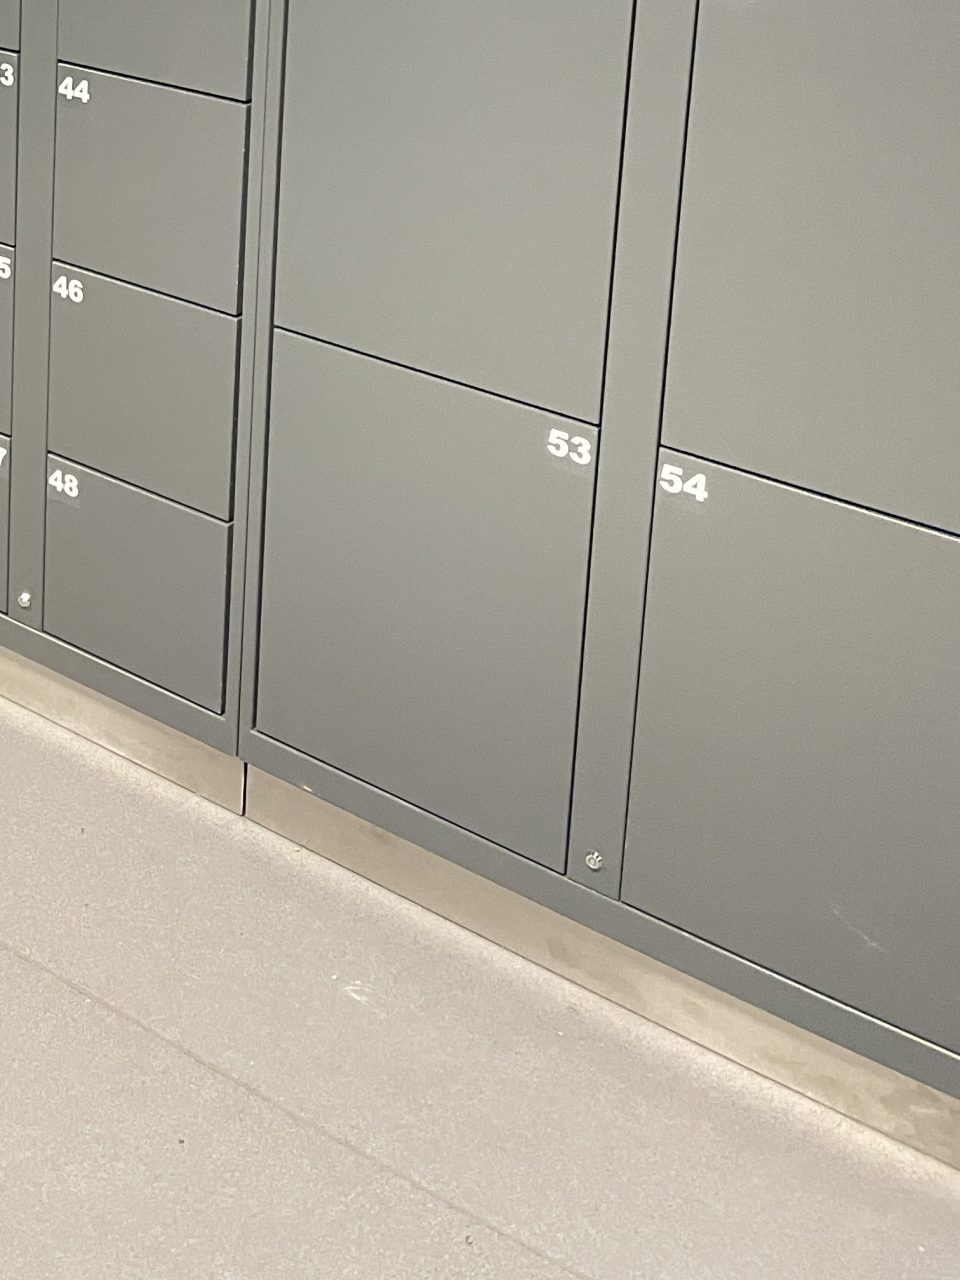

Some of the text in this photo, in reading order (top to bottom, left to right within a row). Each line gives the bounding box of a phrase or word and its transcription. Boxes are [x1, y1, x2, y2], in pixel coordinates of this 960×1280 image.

[58, 76, 90, 104] 44
[52, 275, 84, 303] 46
[546, 428, 592, 465] 53
[48, 469, 79, 498] 48
[659, 463, 709, 503] 54
